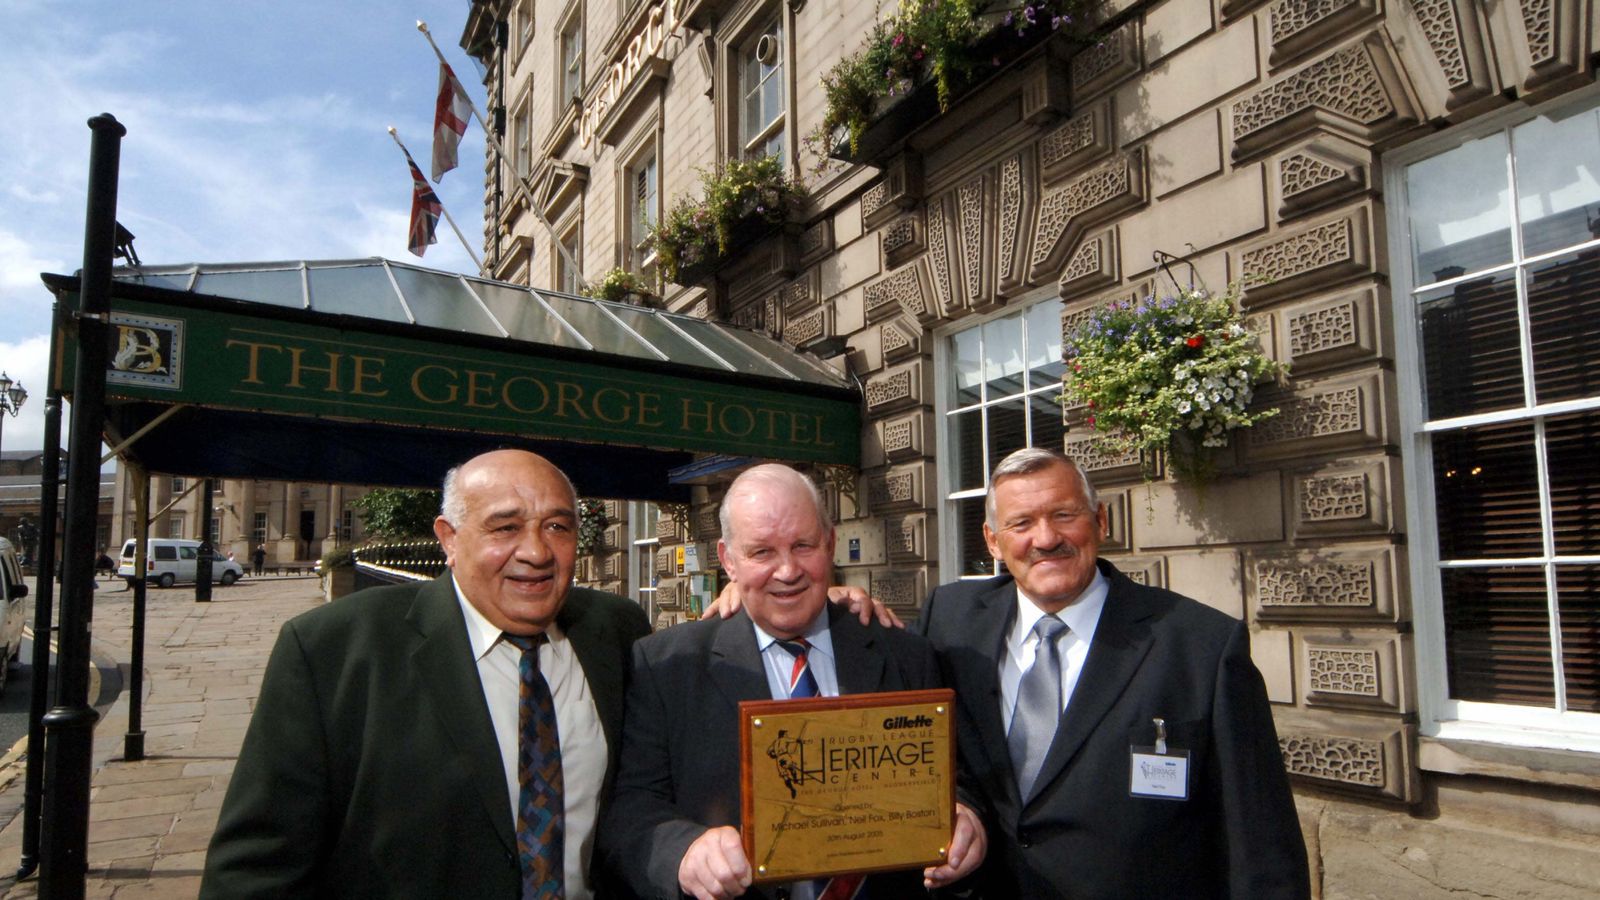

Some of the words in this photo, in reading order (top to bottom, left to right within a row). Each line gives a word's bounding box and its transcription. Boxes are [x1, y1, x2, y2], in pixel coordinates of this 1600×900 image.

[226, 339, 390, 397] THE
[410, 364, 665, 427] GEORGE
[681, 399, 836, 447] HOTEL
[882, 715, 934, 730] Gillette
[829, 734, 874, 745] RUGBY
[883, 729, 934, 741] LEAGUE
[799, 738, 935, 786] HERITAGE
[830, 766, 935, 785] CENTRE
[771, 820, 809, 833] Michael
[849, 814, 867, 826] Neil
[906, 808, 937, 820] Boston
